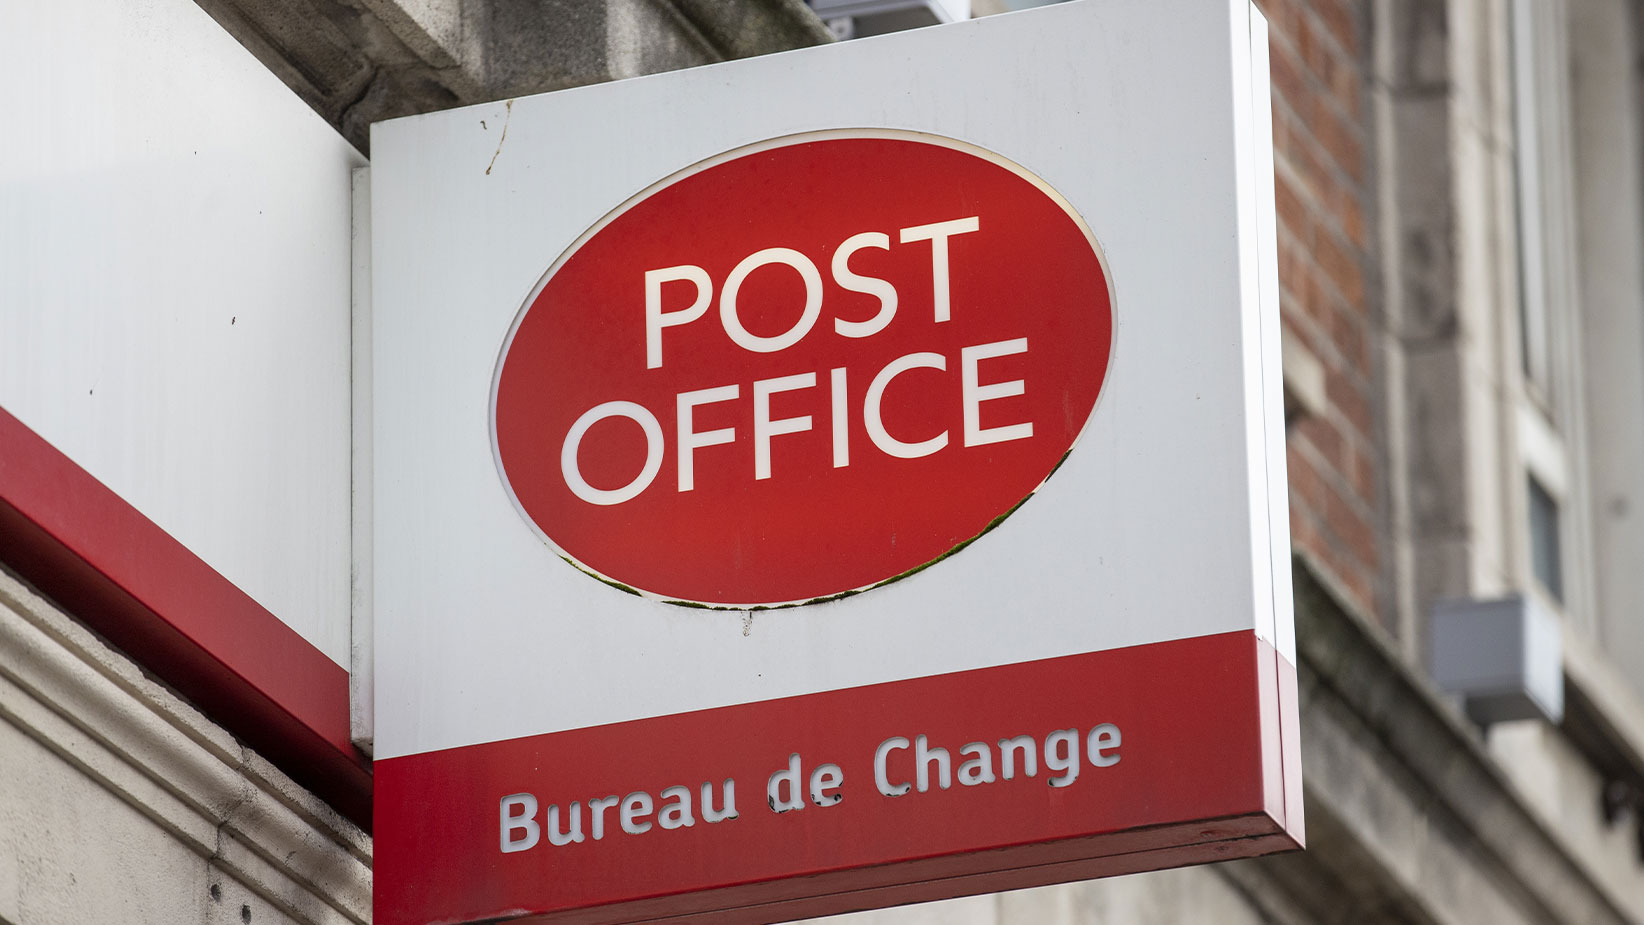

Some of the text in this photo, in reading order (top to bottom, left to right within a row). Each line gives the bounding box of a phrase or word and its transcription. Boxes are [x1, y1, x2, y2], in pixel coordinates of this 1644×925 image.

[644, 215, 980, 370] POST
[560, 337, 1034, 506] OFFICE
[499, 722, 1123, 854] Bureau de Change
